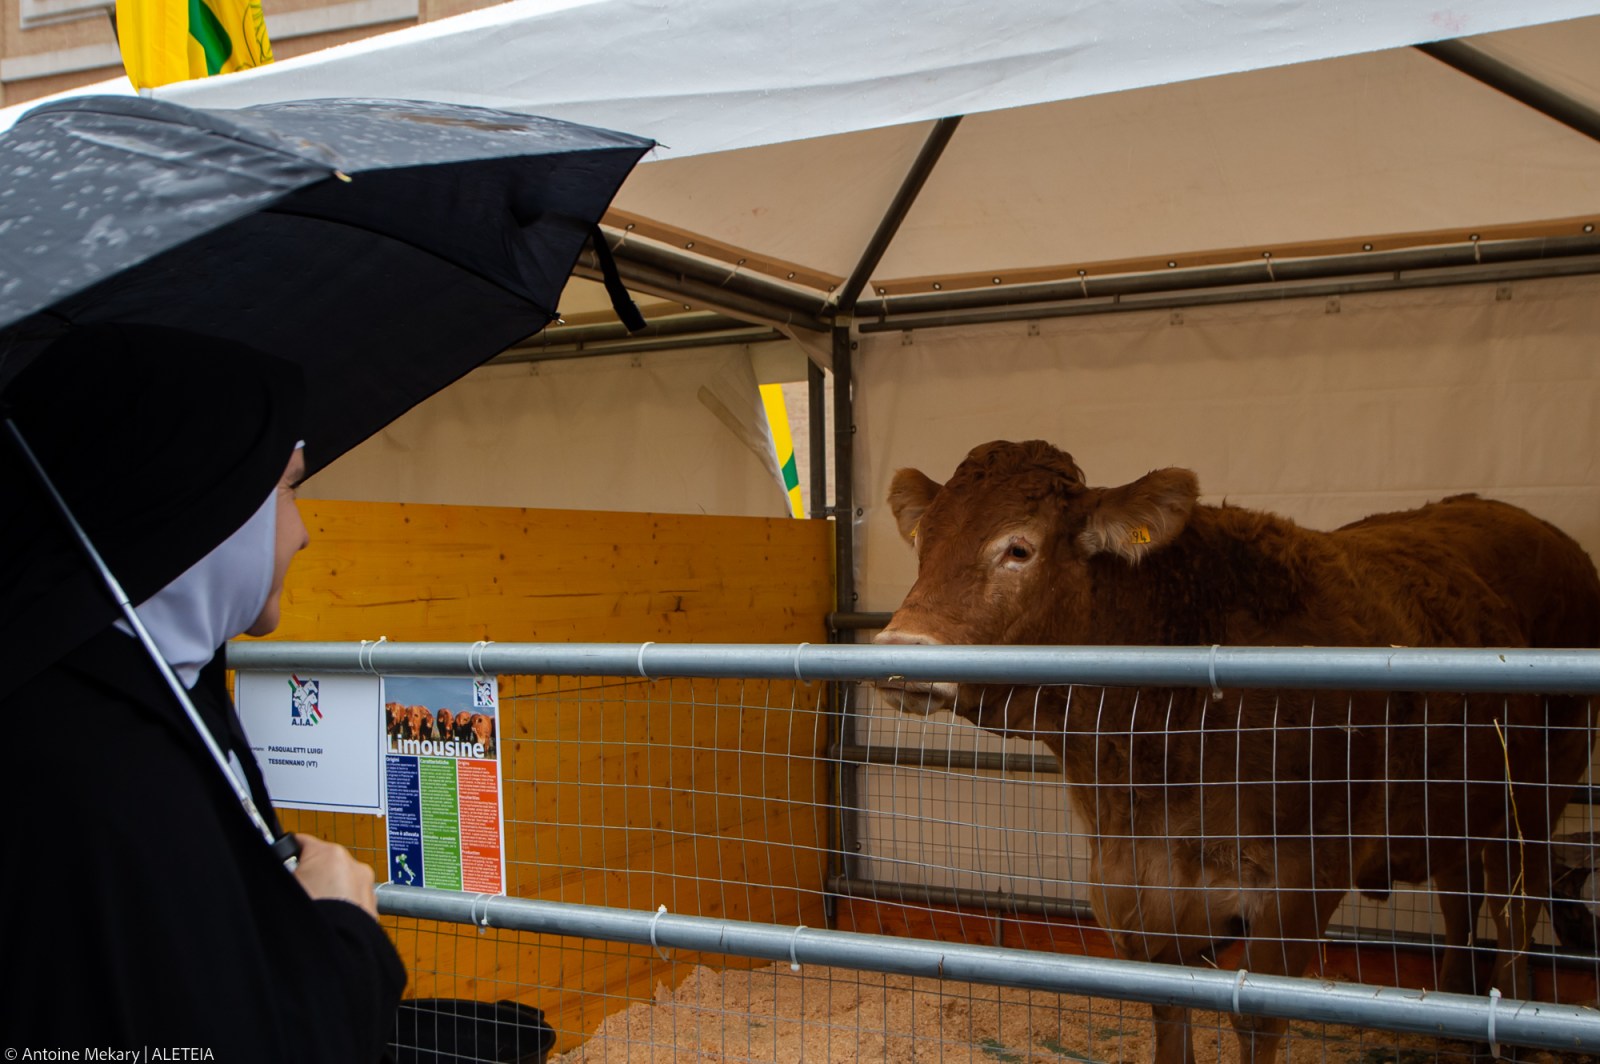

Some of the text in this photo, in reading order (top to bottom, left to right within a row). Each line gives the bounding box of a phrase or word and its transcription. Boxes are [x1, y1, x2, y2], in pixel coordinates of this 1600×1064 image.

[1132, 530, 1147, 543] 94
[291, 719, 313, 727] A.I.A.
[268, 746, 305, 754] PASQUALETTI
[387, 734, 485, 758] Limousine
[268, 759, 318, 769] TESSENNANO (VT)
